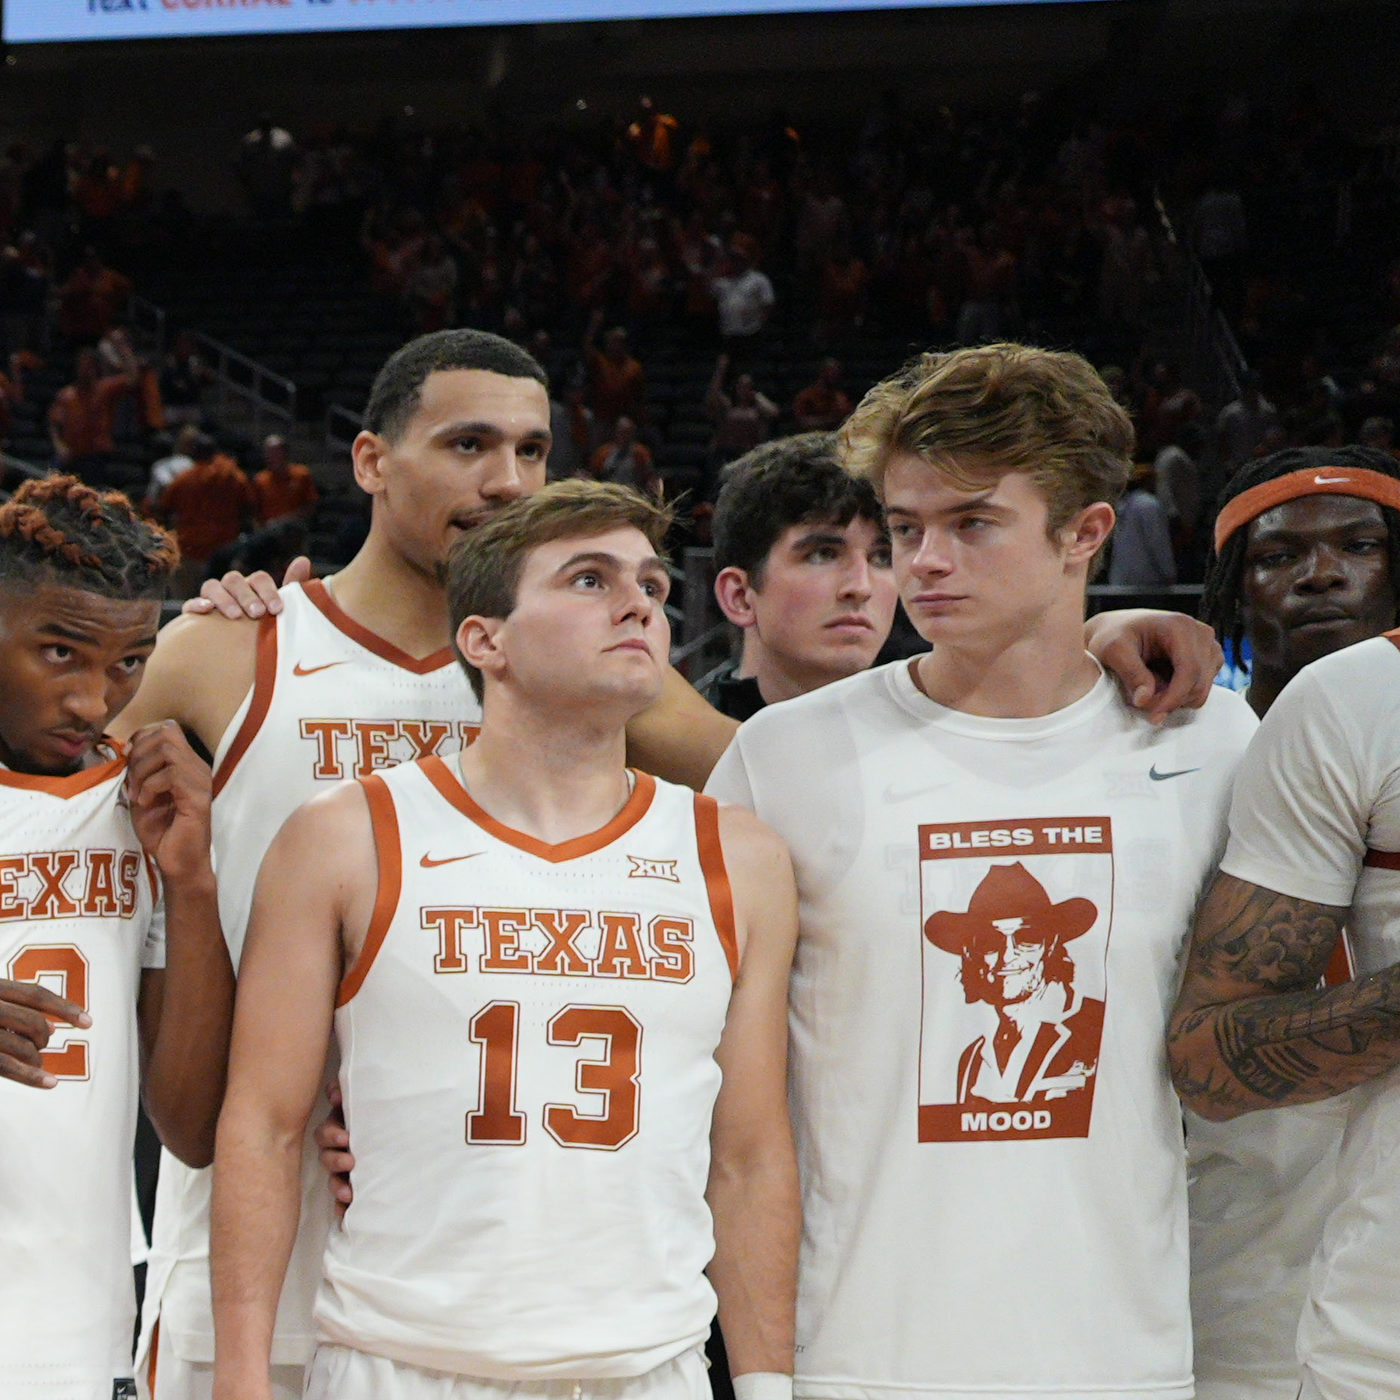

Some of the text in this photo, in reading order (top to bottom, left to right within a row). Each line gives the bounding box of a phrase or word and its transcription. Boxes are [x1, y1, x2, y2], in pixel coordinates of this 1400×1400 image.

[929, 826, 1103, 850] BLESS THE
[420, 905, 695, 984] TEXAS
[465, 999, 643, 1151] 13
[961, 1110, 1052, 1132] MOOD
